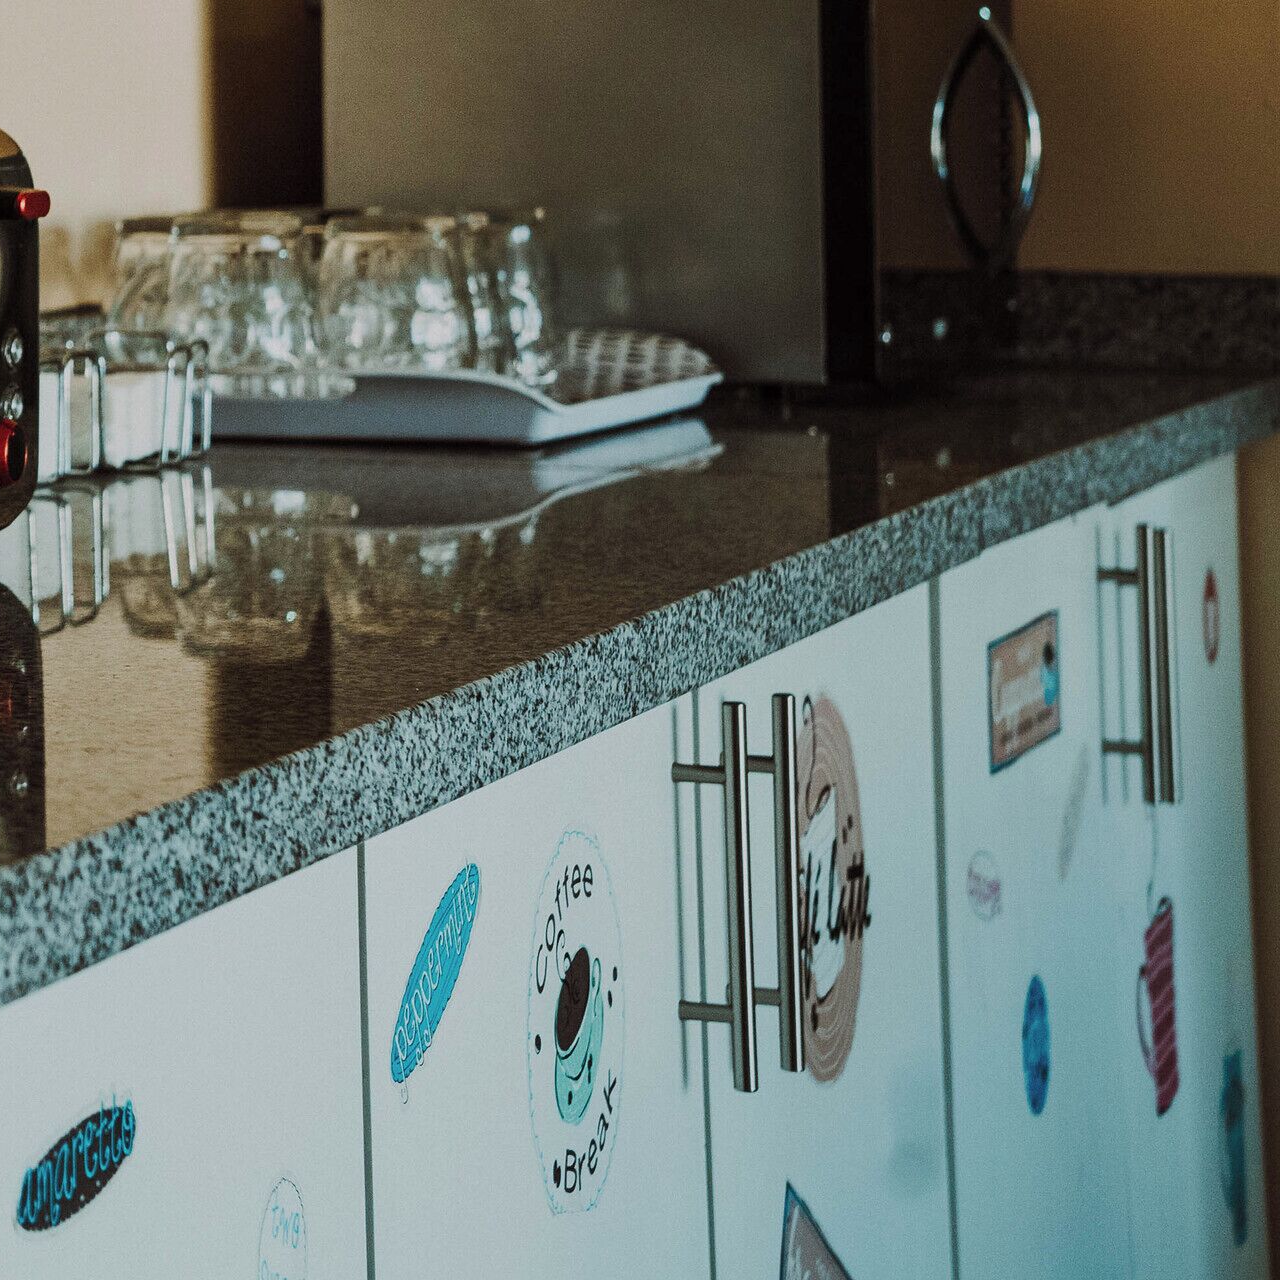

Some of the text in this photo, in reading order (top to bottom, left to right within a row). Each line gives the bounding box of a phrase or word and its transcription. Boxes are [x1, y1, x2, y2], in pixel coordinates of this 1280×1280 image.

[394, 858, 476, 1104] peppermint
[536, 864, 593, 994] Coffee
[16, 1095, 135, 1227] amaretto
[564, 1069, 617, 1193] Break
